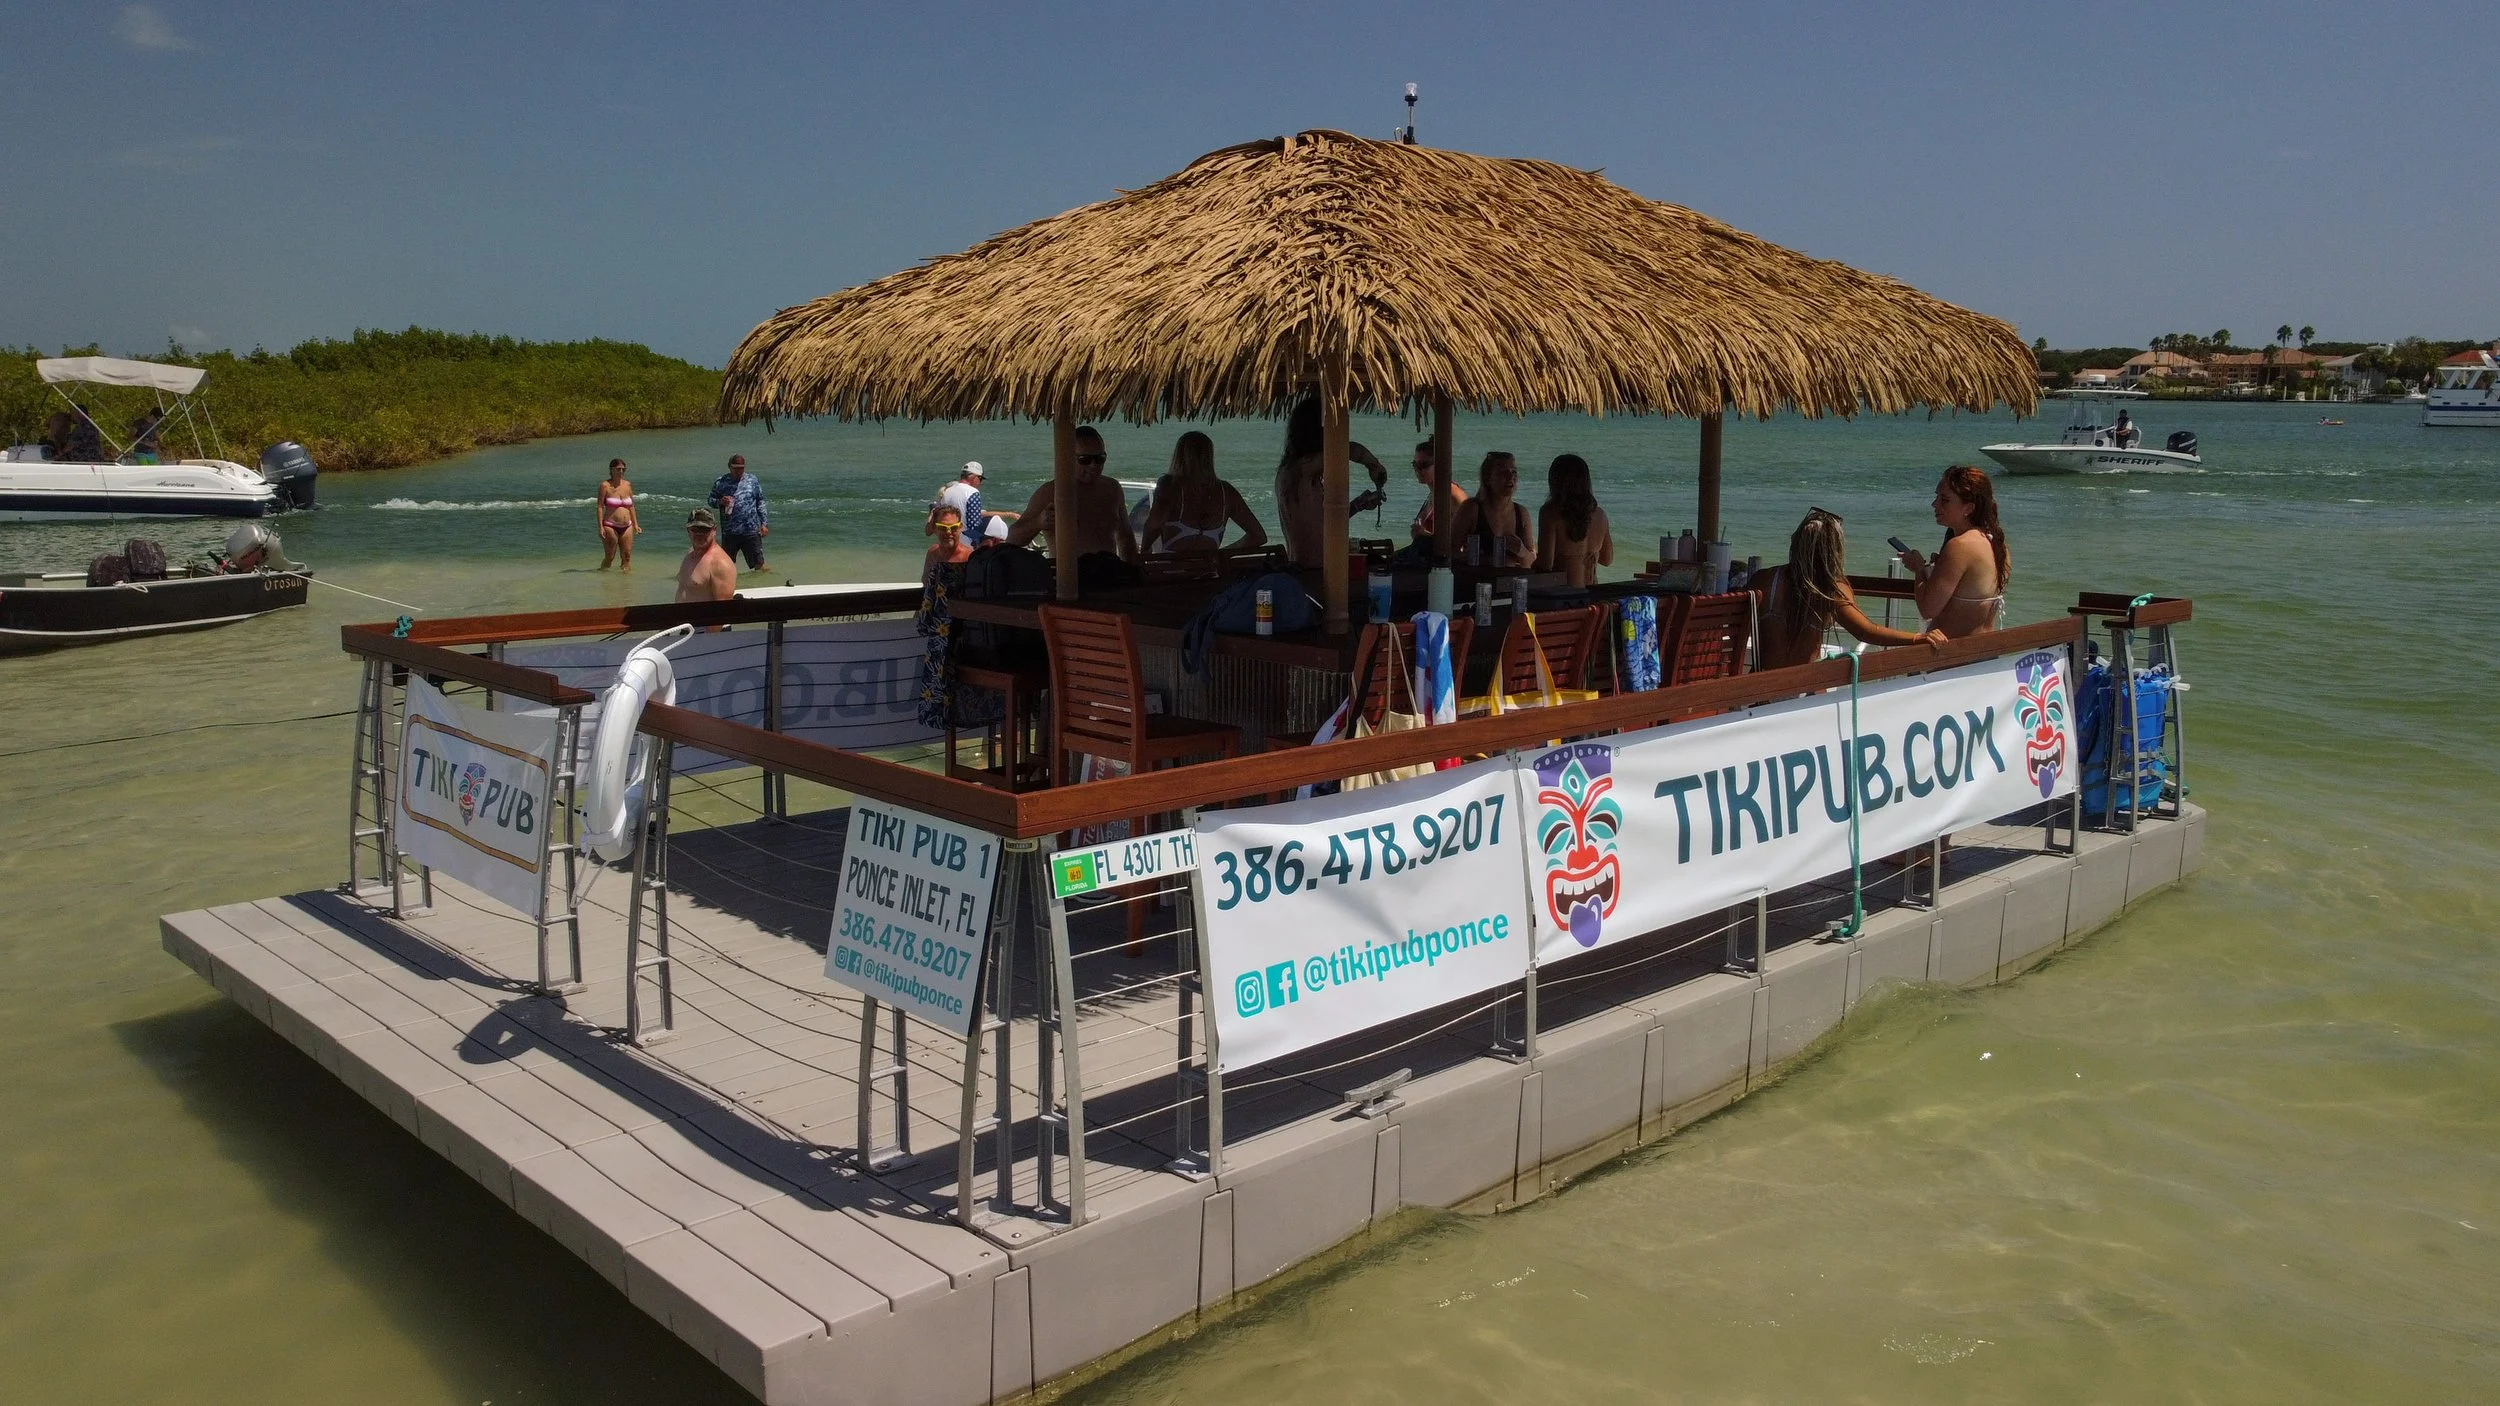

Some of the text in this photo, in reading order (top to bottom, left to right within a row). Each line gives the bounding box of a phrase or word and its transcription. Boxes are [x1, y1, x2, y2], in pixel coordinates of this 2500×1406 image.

[2098, 455, 2165, 466] SHERIFF
[412, 747, 534, 835] TIKI PUB
[1653, 705, 2006, 865] TIKIPUB.COM
[858, 807, 991, 879] TIKI PUB 1
[1094, 833, 1195, 884] FL 4307 TH
[1213, 793, 1505, 911] 386.478.9207
[846, 856, 977, 938] PONCE INLET, FL
[1065, 882, 1089, 891] FLORIDA
[839, 908, 972, 981] 386.478.9207
[1303, 913, 1509, 993] @tikipubponce
[863, 958, 963, 1015] @tikipubponce
